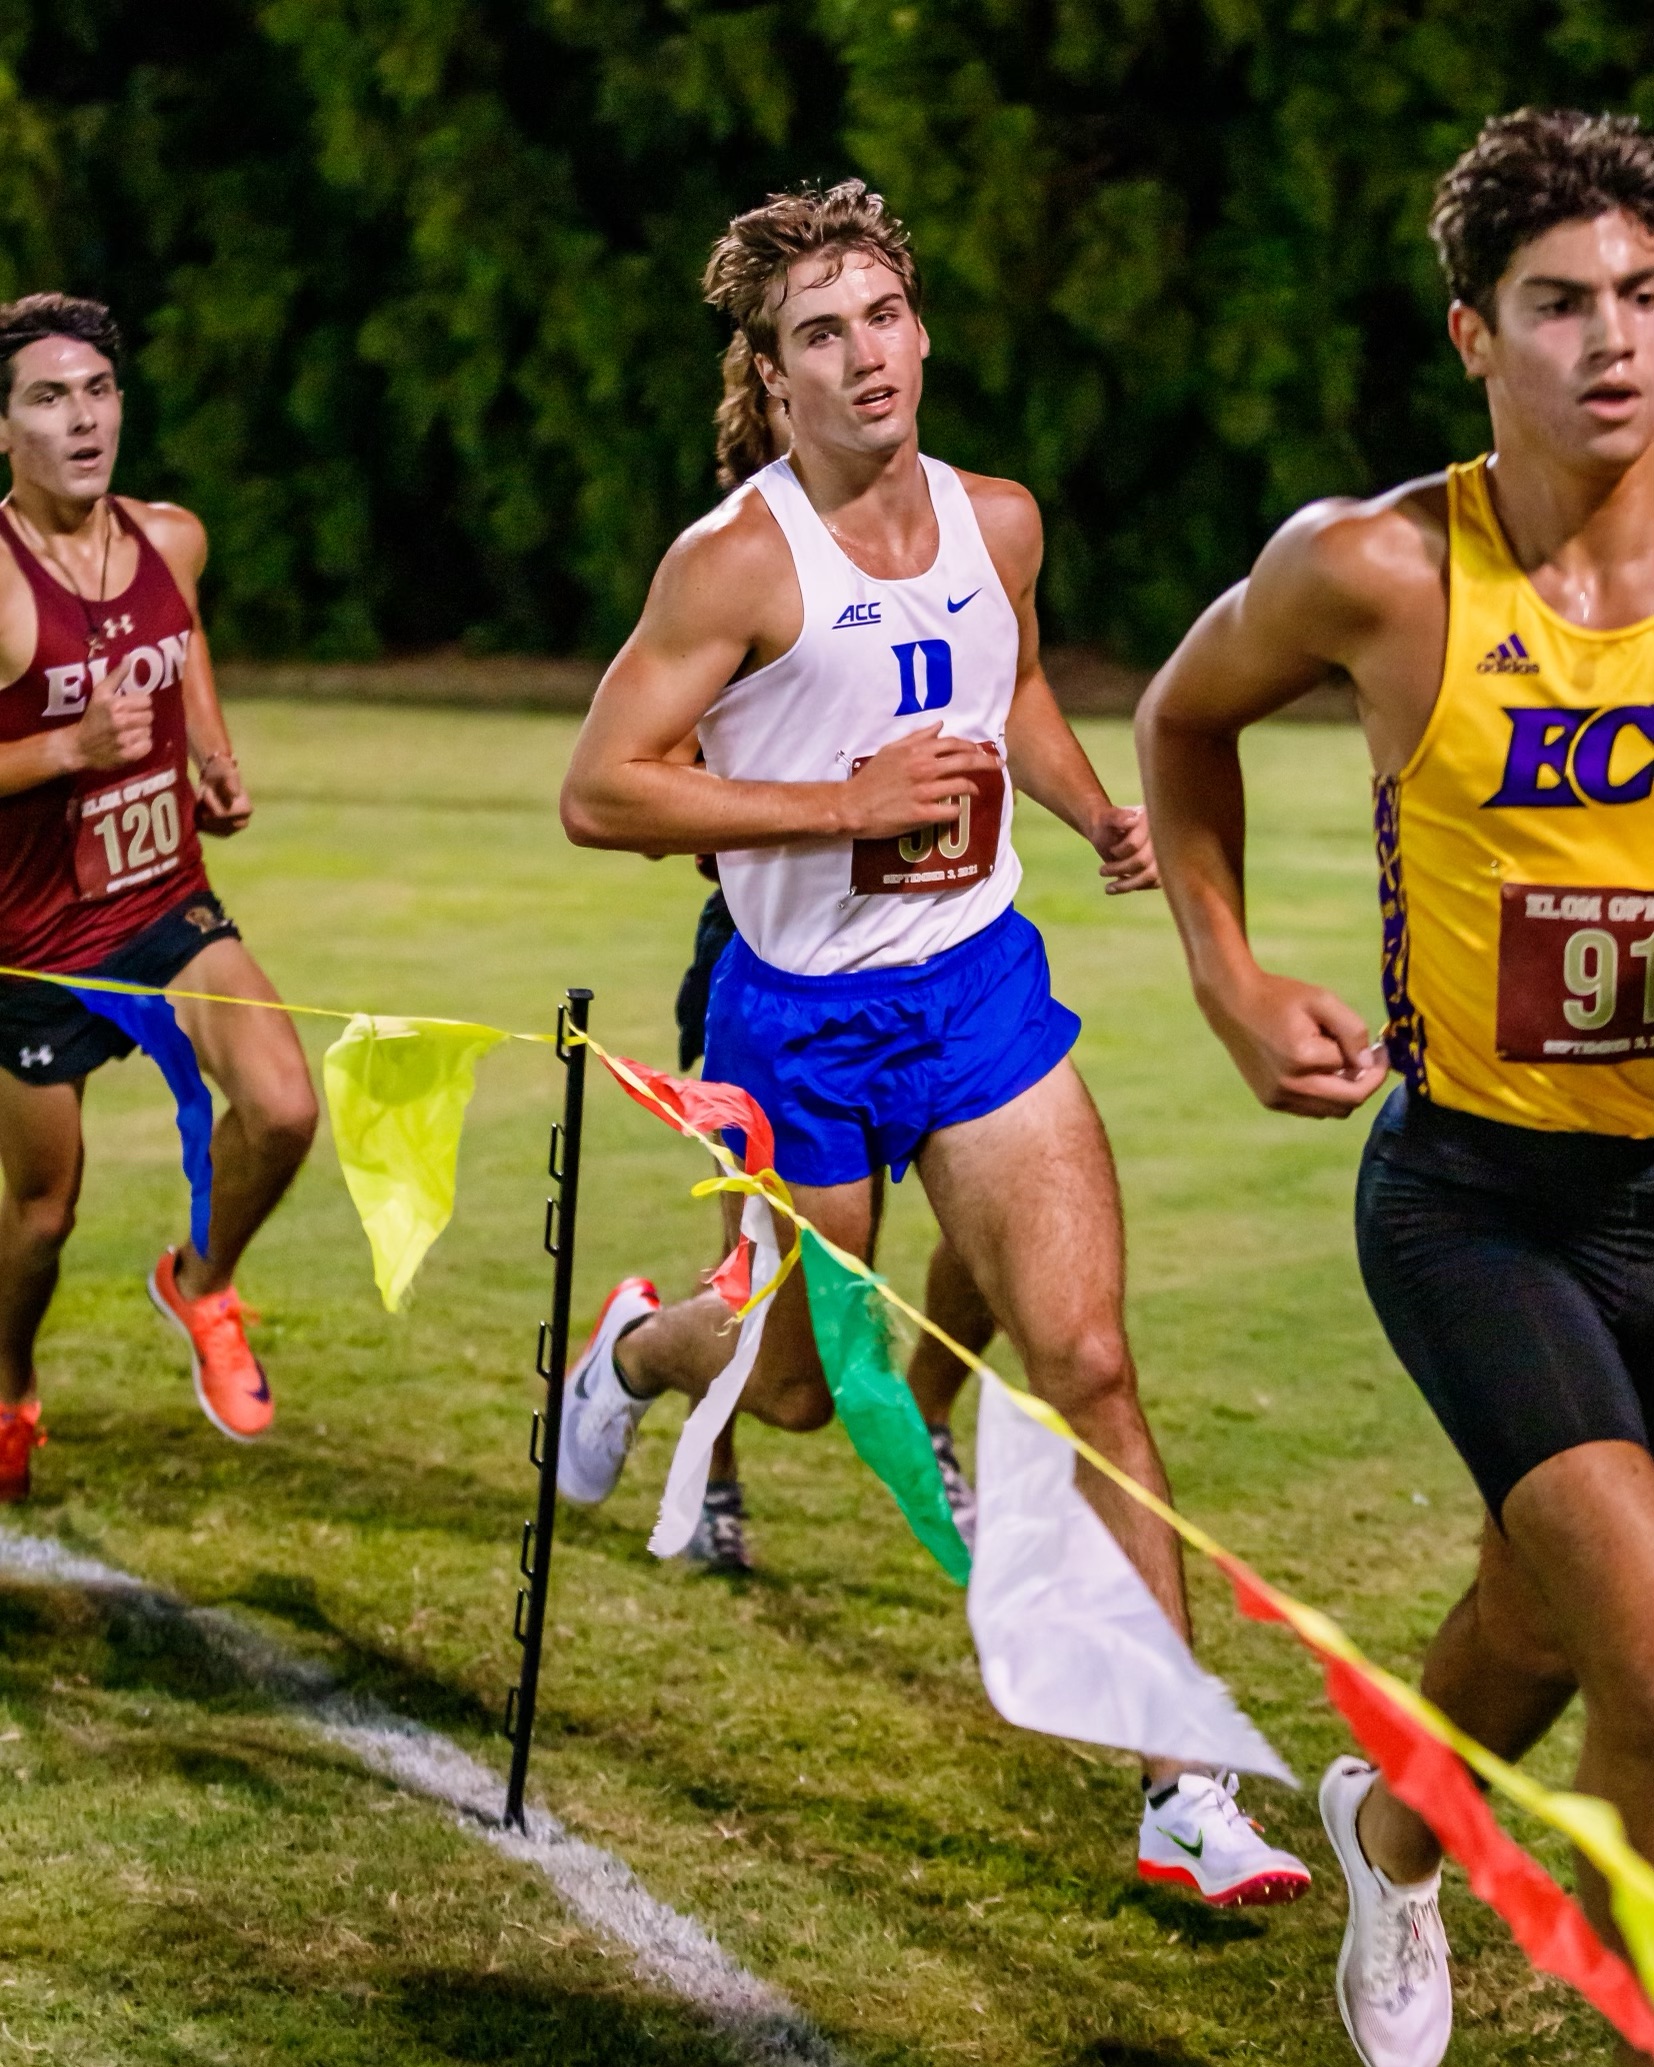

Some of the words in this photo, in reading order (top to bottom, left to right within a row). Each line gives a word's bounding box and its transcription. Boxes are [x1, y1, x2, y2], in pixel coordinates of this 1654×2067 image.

[834, 602, 881, 626] ACC
[891, 639, 953, 717] D
[1476, 658, 1540, 674] adidas
[94, 790, 181, 875] 120
[1525, 893, 1602, 921] ELON
[1563, 928, 1654, 1031] 91
